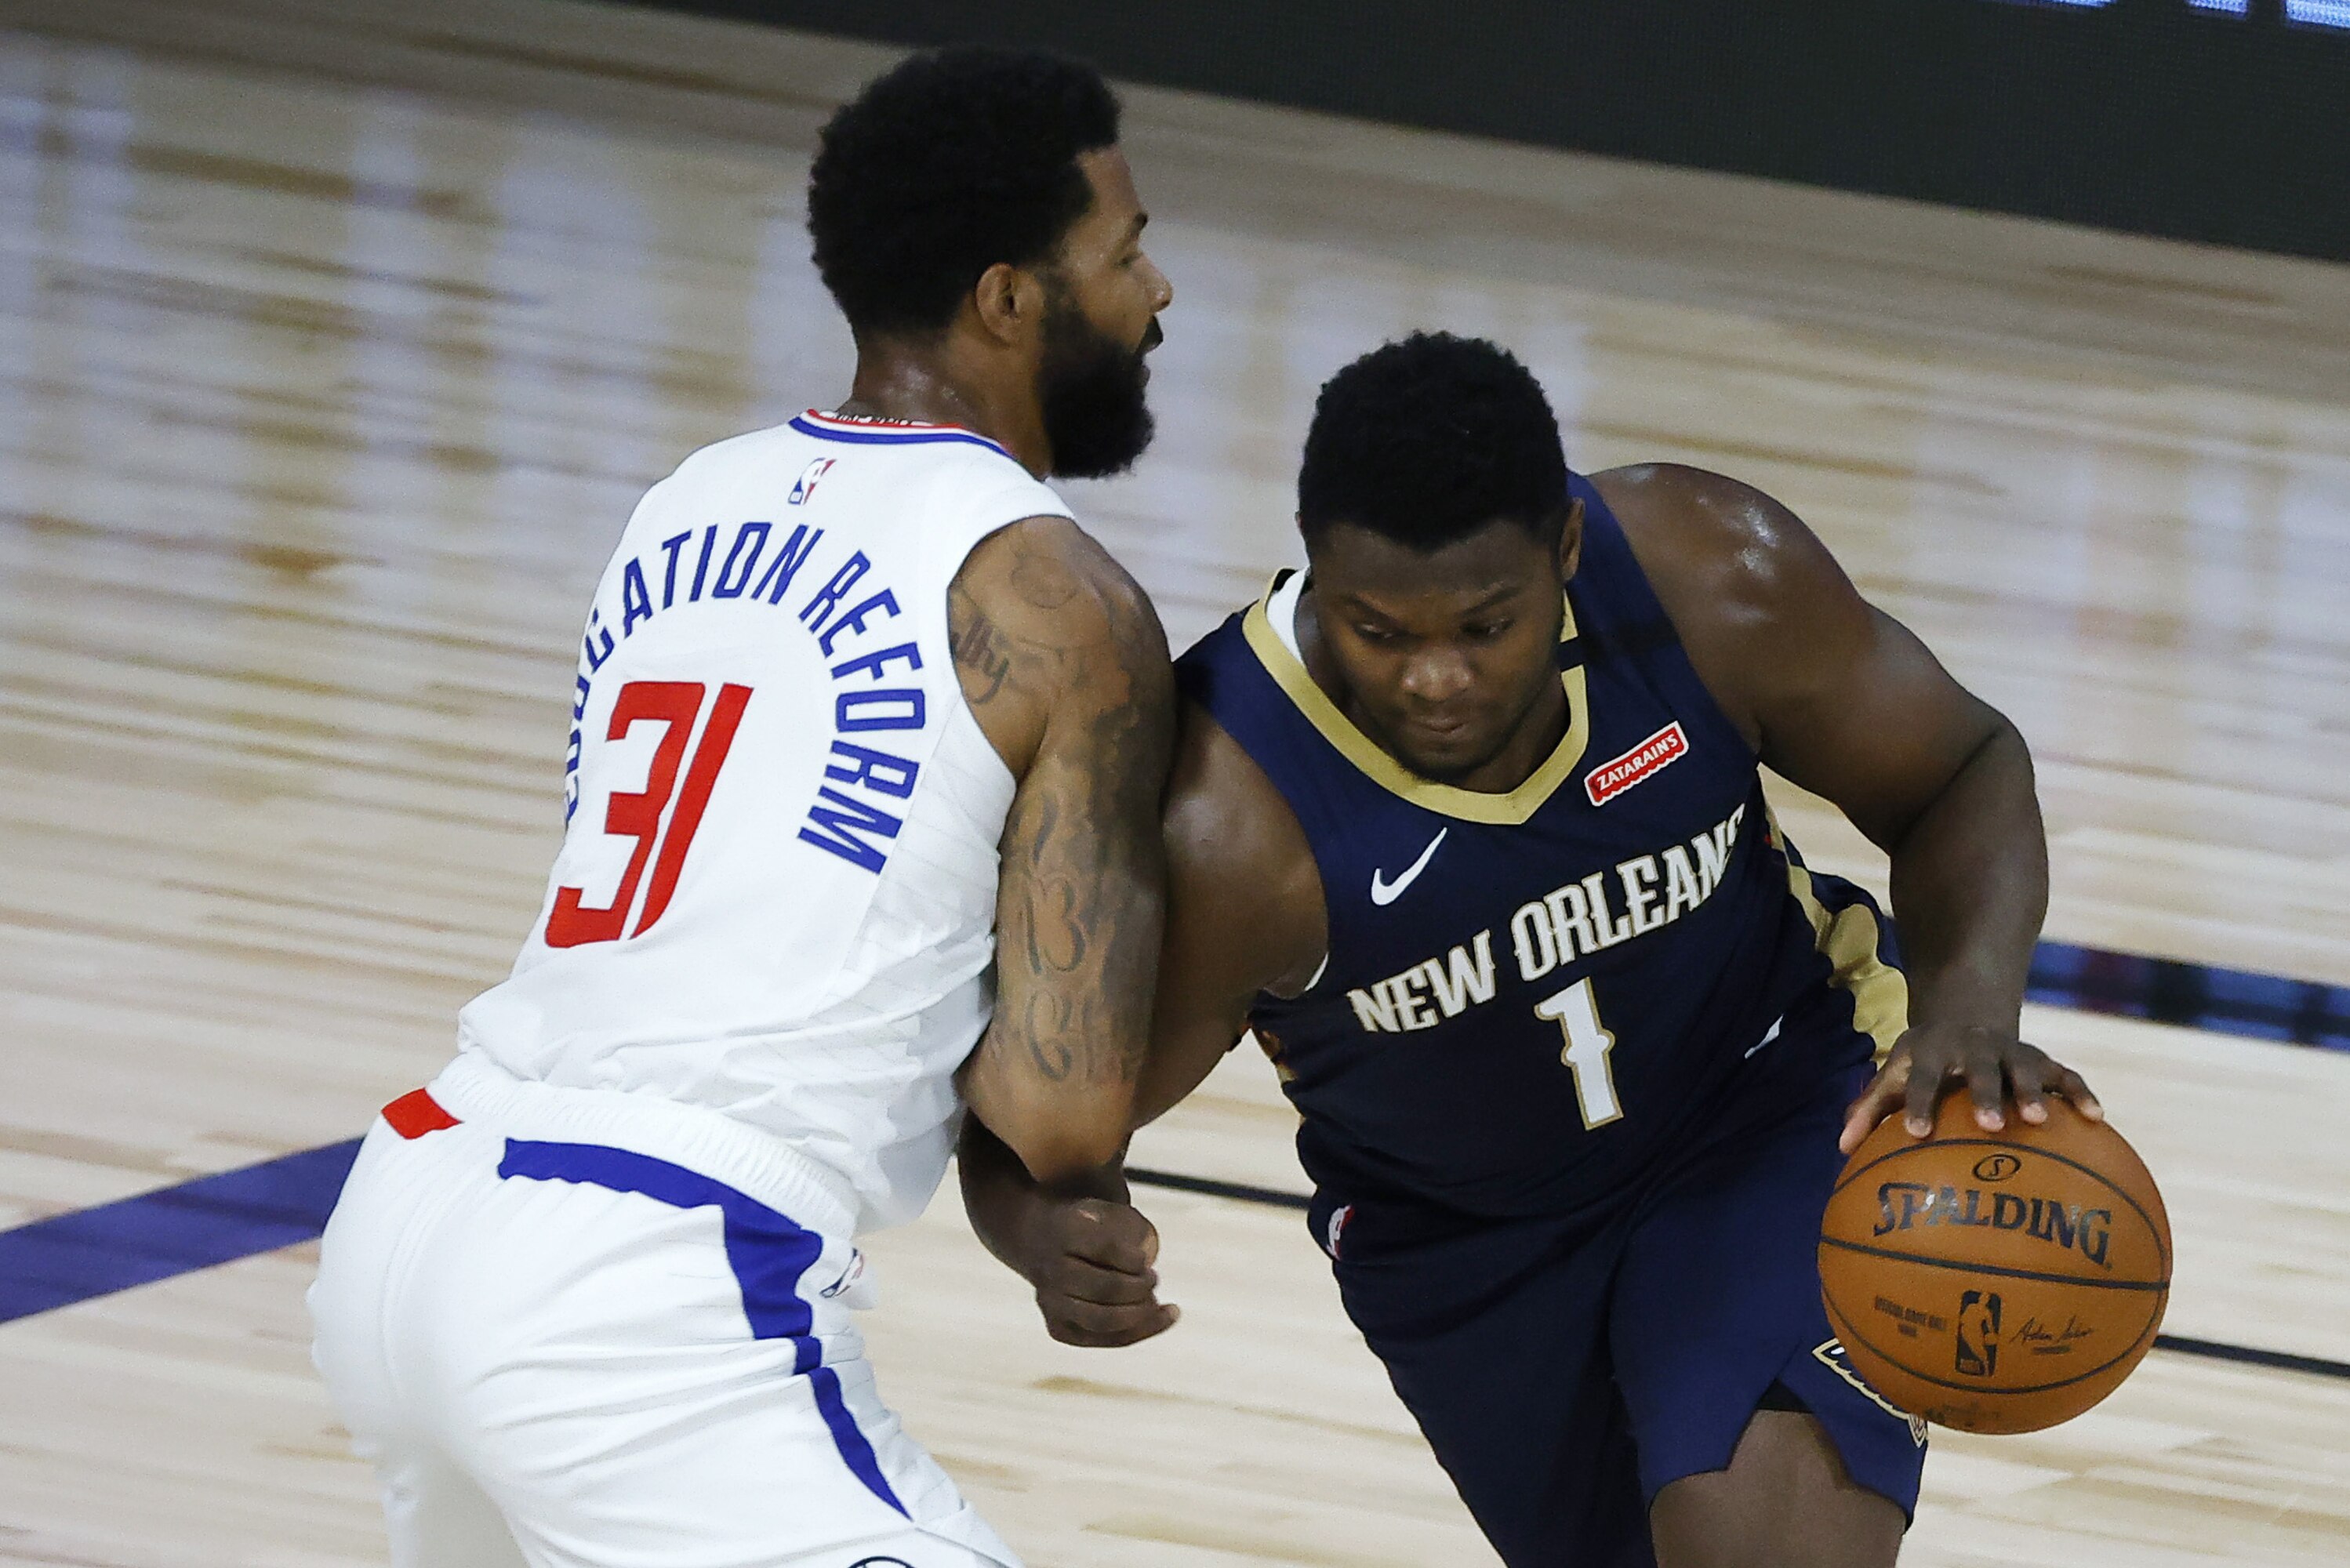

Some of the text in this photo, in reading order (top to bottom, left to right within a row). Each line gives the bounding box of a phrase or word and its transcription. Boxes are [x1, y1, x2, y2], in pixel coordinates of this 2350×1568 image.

[798, 550, 927, 875] REFORM
[547, 681, 754, 949] 31
[1346, 928, 1496, 1033] NEW
[1534, 975, 1624, 1131] 1
[1873, 1181, 2112, 1266] SPALDING
